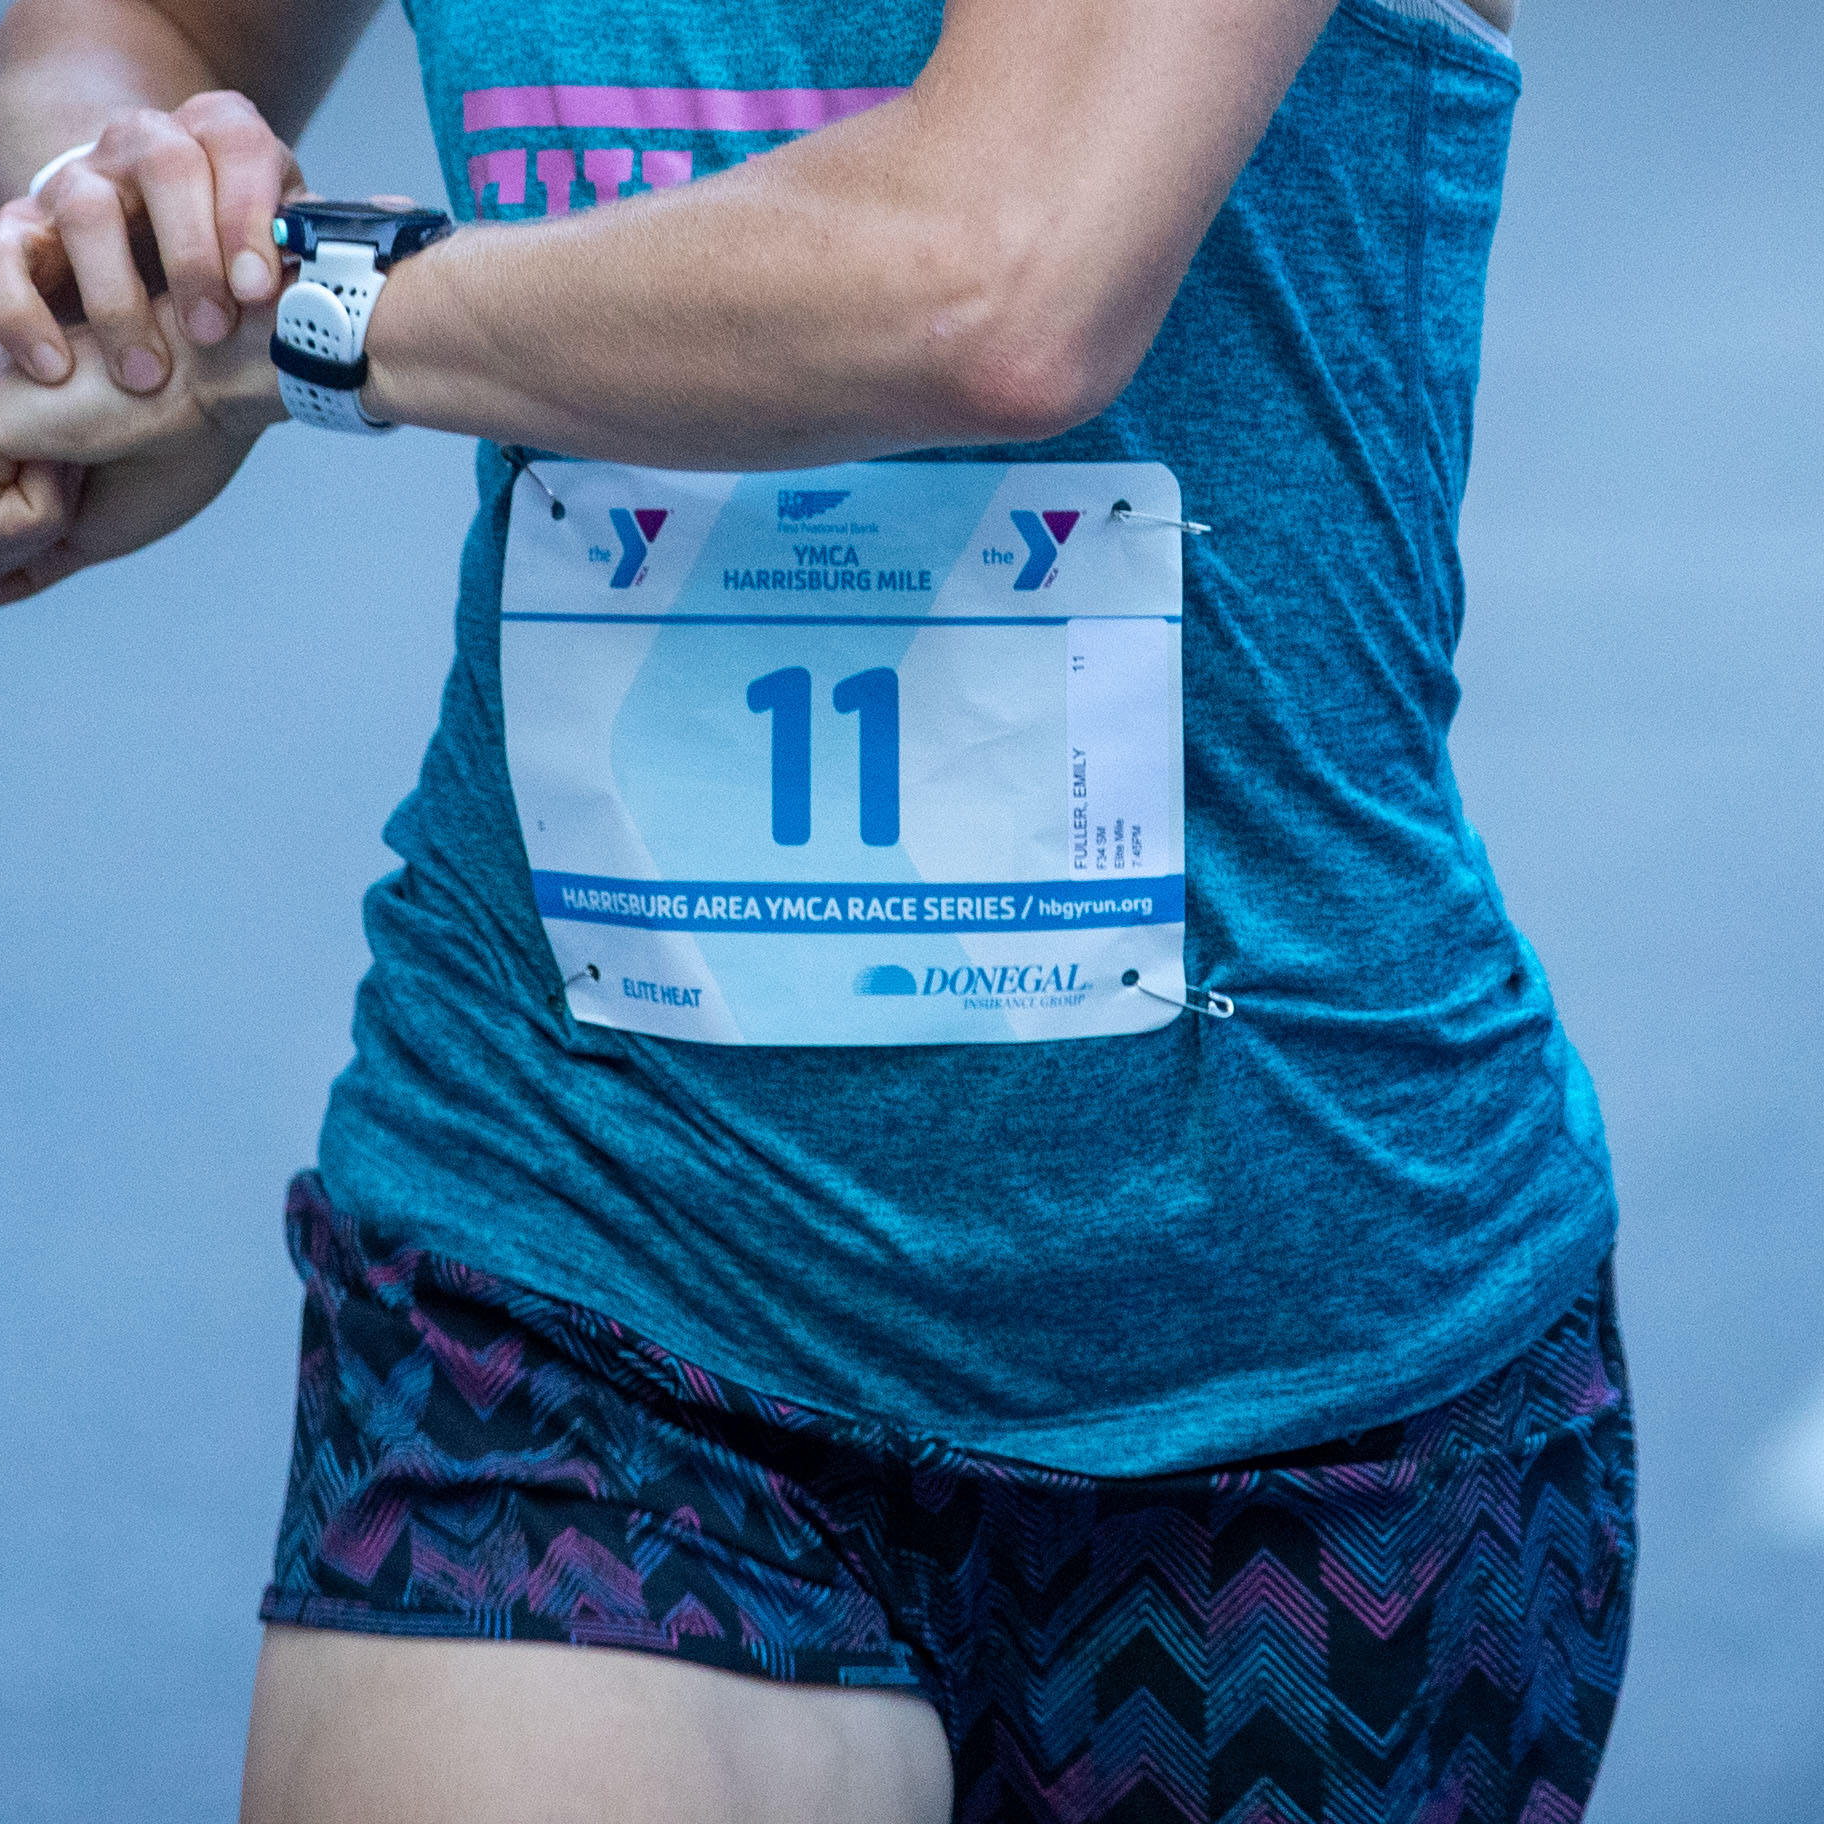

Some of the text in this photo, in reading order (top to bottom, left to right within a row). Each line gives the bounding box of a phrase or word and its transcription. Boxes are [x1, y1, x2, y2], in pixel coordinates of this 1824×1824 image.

[588, 545, 611, 563] the
[792, 544, 860, 567] YMCA
[982, 547, 1015, 566] the
[723, 568, 932, 592] HARRISBURG MILE
[746, 665, 900, 847] 11
[1073, 747, 1087, 798] EMILY
[1073, 801, 1088, 870] FULLER,
[562, 887, 689, 920] HARRISBURG
[693, 896, 762, 920] AREA
[765, 896, 842, 921] YMCA
[847, 897, 917, 921] RACE
[923, 896, 1016, 921] SERIES
[1038, 897, 1153, 920] hbgyrun.org
[622, 977, 702, 1008] ELITE HEAT
[921, 963, 1087, 996] DONEGAL
